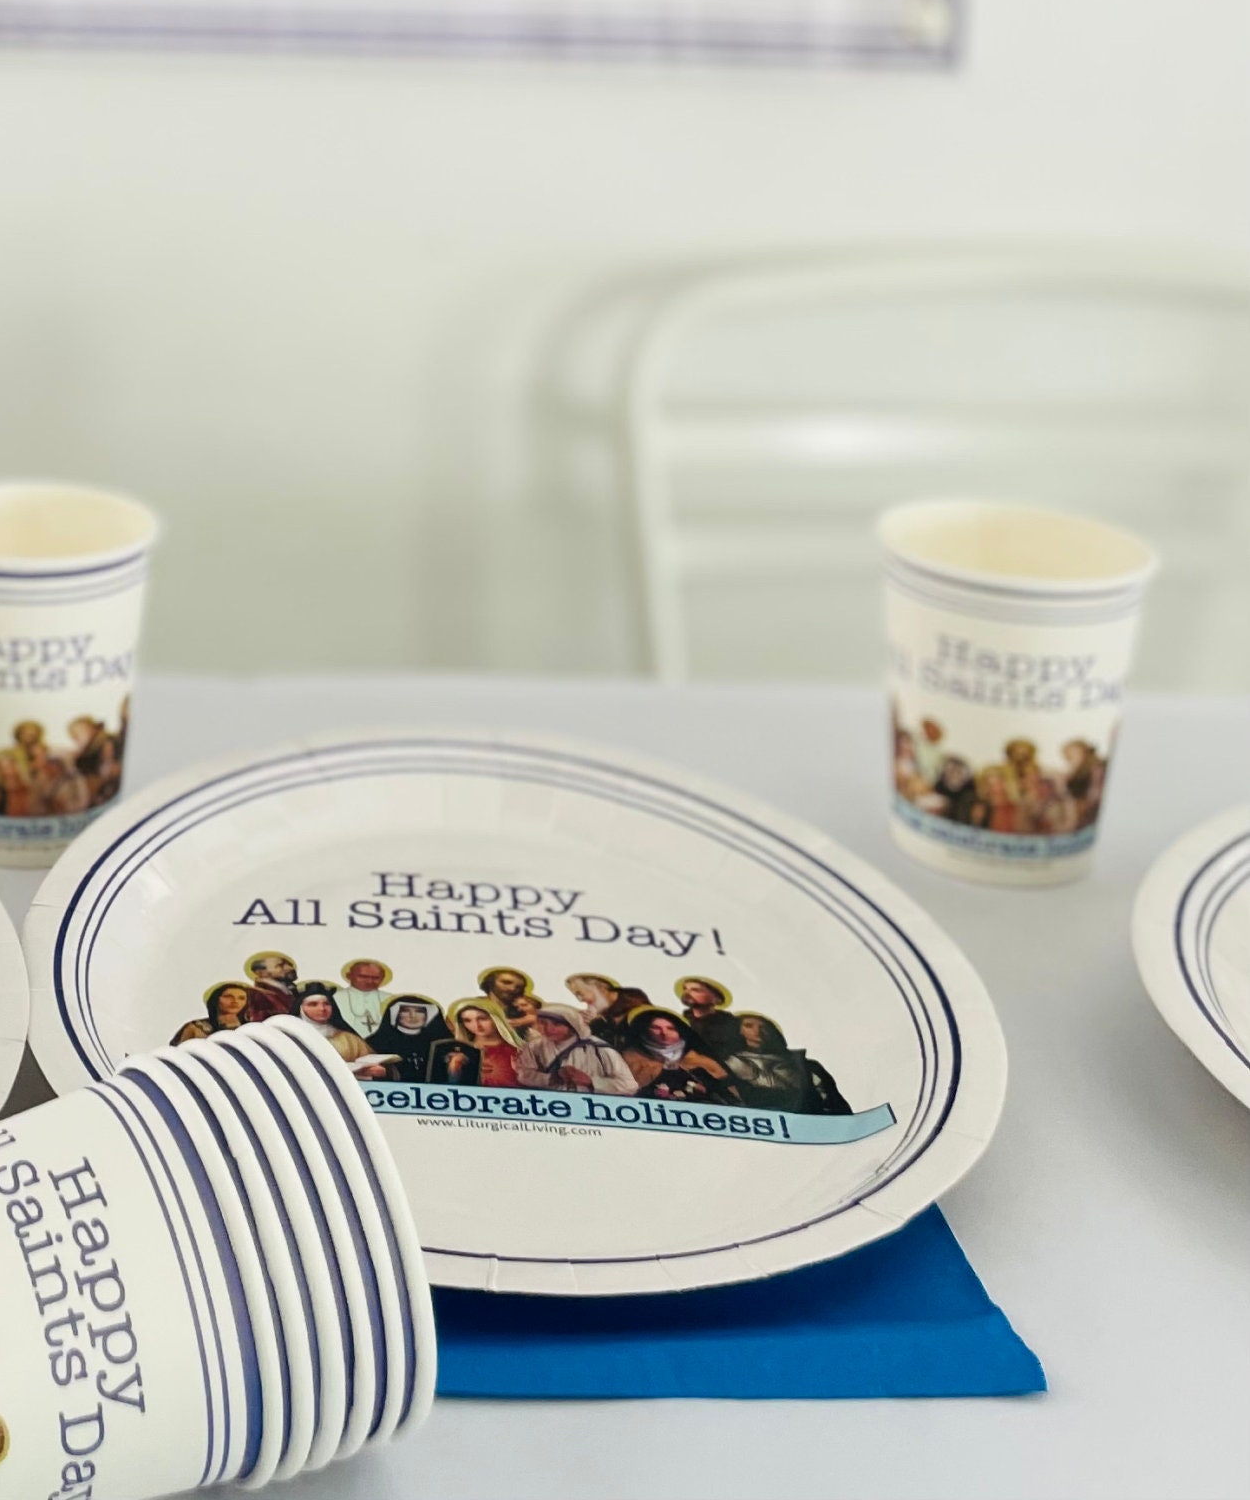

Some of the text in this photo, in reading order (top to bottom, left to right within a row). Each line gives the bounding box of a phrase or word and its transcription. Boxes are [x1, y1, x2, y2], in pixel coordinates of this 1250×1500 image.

[937, 633, 1097, 686] Happy
[371, 871, 586, 914] Happy
[233, 898, 726, 958] All Saints Day!
[364, 1087, 790, 1138] celebrate holiness!
[417, 1117, 602, 1137] www.LiturgicalLiving.com
[48, 1157, 146, 1413] Happy
